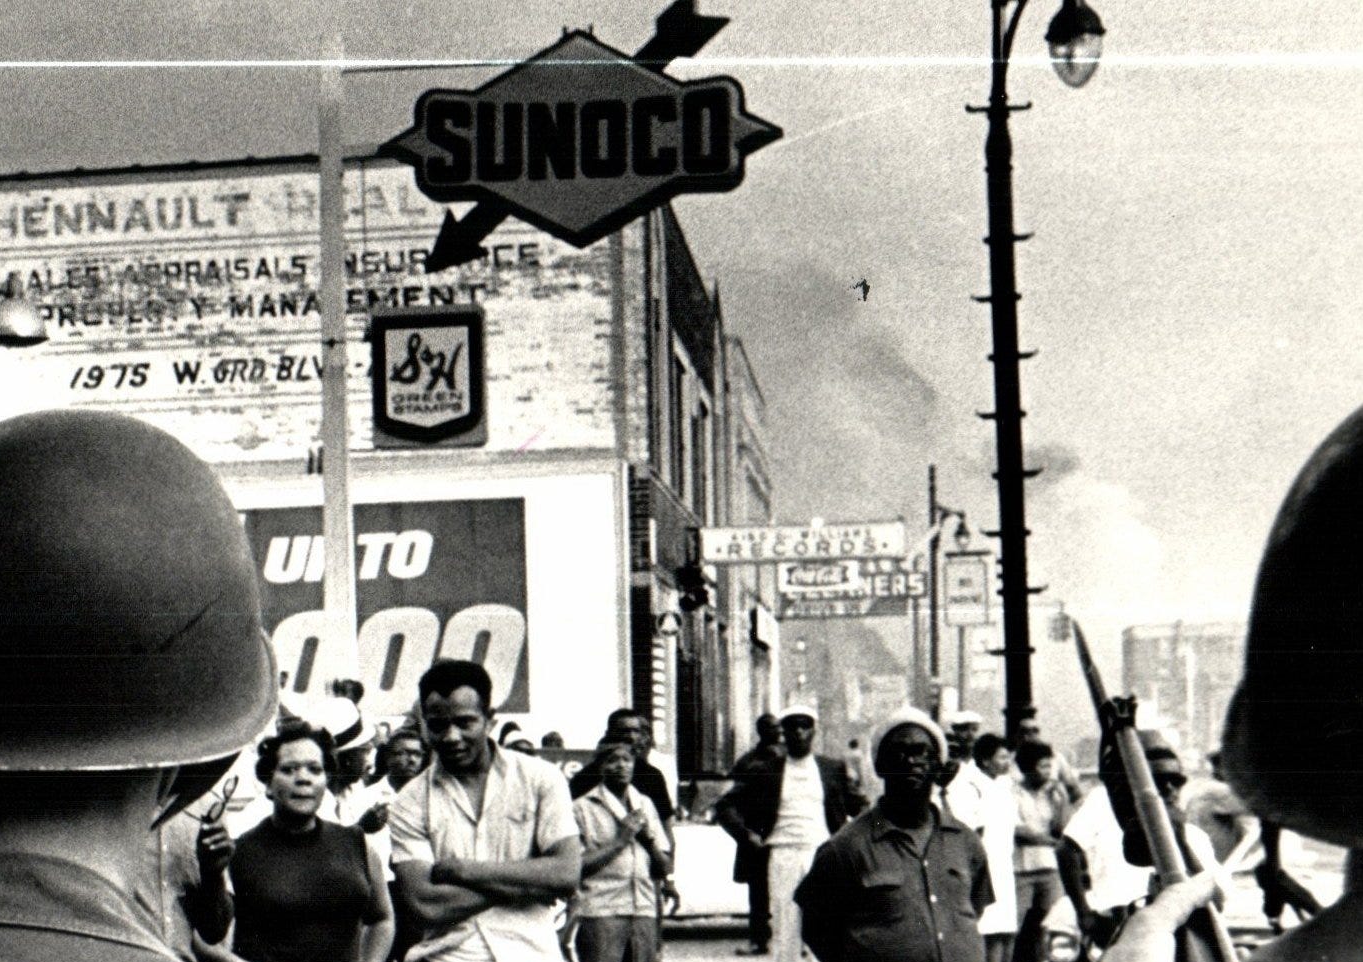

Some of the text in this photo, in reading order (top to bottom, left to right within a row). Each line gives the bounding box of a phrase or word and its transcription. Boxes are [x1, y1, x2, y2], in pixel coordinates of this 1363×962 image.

[425, 86, 733, 184] SUNOCO
[229, 283, 487, 320] MANAEMENT
[70, 362, 151, 391] 1975
[391, 391, 463, 404] GREEN
[393, 402, 462, 416] STAMPS
[356, 529, 434, 580] TO
[726, 537, 876, 558] RECORDS
